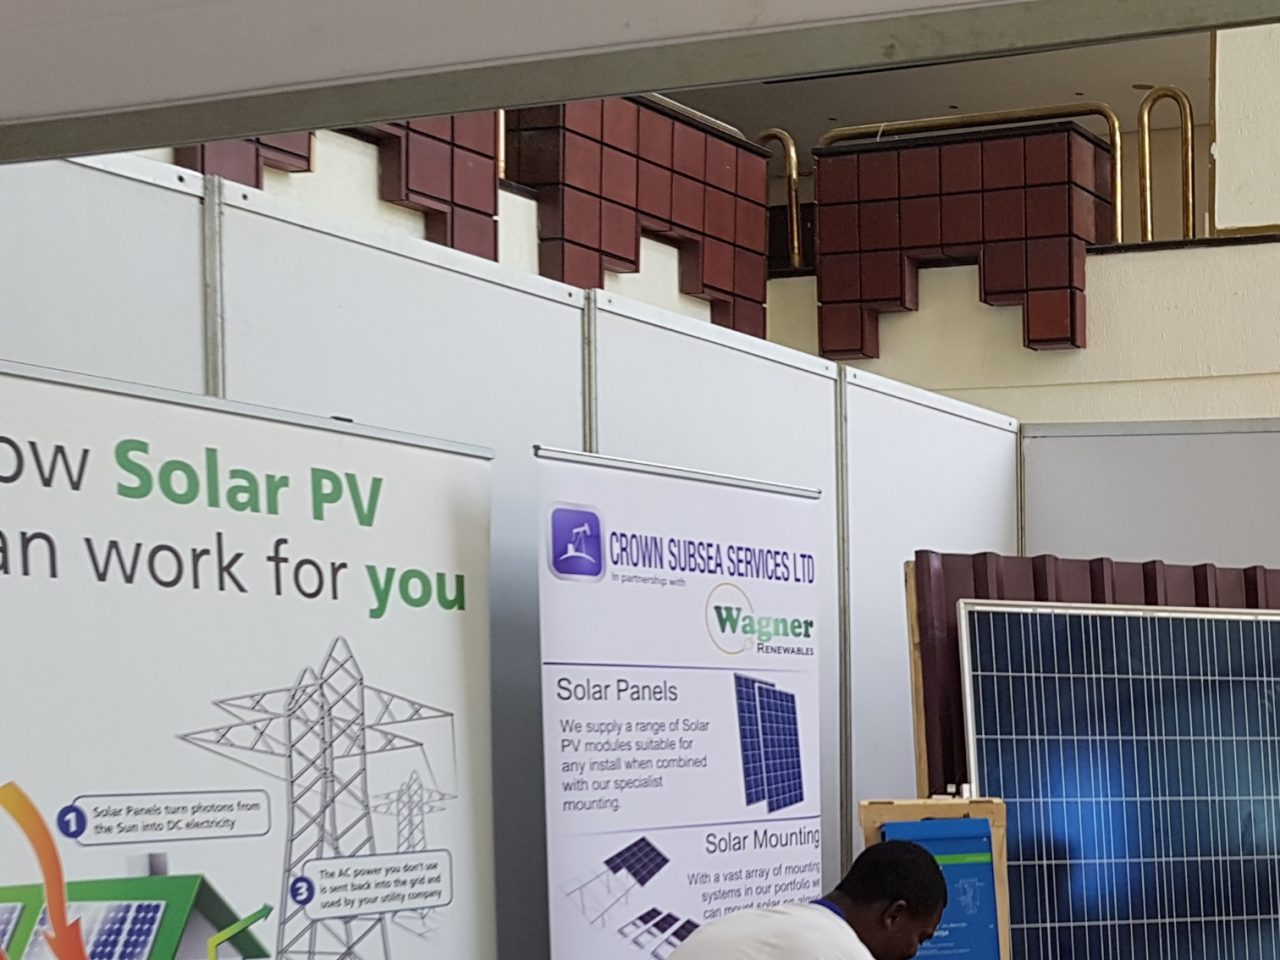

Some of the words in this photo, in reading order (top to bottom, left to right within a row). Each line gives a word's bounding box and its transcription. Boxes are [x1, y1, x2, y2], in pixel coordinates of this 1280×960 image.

[114, 439, 290, 515] Solar
[311, 467, 383, 527] PV
[610, 531, 664, 569] CROWN
[668, 538, 724, 575] SUBSEA
[727, 545, 790, 582] SERVICES
[794, 553, 815, 583] LTD
[84, 532, 248, 593] work
[267, 538, 347, 600] for
[365, 564, 465, 619] you
[611, 573, 619, 581] In
[621, 574, 666, 586] partnership
[669, 577, 686, 586] with
[714, 606, 814, 642] Wagner
[757, 643, 814, 656] RENEWABLES
[557, 677, 611, 701] Solar
[617, 679, 678, 701] Panels
[560, 719, 583, 733] We
[586, 719, 622, 735] supply
[625, 722, 632, 732] a
[635, 720, 666, 735] range
[669, 718, 679, 732] of
[682, 718, 710, 732] Solar
[561, 739, 581, 752] PV
[584, 738, 632, 751] modules
[635, 737, 676, 750] suitable
[679, 737, 694, 750] for
[562, 760, 585, 775] any
[589, 757, 621, 771] install
[624, 756, 653, 770] when
[656, 755, 707, 769] combined
[562, 778, 589, 792] with
[592, 779, 611, 791] our
[614, 775, 663, 792] specialist
[93, 805, 122, 818] Solar
[126, 804, 161, 817] Panels
[165, 804, 188, 815] turn
[191, 802, 234, 816] photons
[237, 800, 260, 811] from
[64, 812, 77, 832] 1
[93, 823, 112, 834] the
[118, 822, 139, 833] Sun
[142, 820, 163, 832] into
[167, 820, 183, 831] DC
[186, 818, 236, 830] electricity
[706, 832, 748, 854] Solar
[754, 826, 820, 849] Mounting
[320, 869, 335, 879] The
[337, 868, 351, 878] AC
[353, 867, 382, 879] power
[385, 866, 400, 877] you
[403, 862, 424, 872] don't
[687, 872, 711, 886] With
[713, 873, 720, 883] a
[722, 868, 742, 881] vast
[745, 868, 770, 880] array
[773, 863, 782, 876] of
[330, 883, 348, 893] sent
[351, 881, 371, 891] back
[374, 880, 391, 889] into
[394, 878, 407, 887] the
[409, 876, 425, 888] grid
[701, 888, 742, 905] systems
[745, 884, 753, 896] in
[755, 884, 772, 896] our
[774, 878, 811, 896] portfolio
[321, 898, 341, 909] used
[344, 897, 355, 908] by
[358, 896, 378, 907] your
[381, 893, 405, 904] utility
[408, 889, 442, 902] company
[703, 908, 721, 920] can
